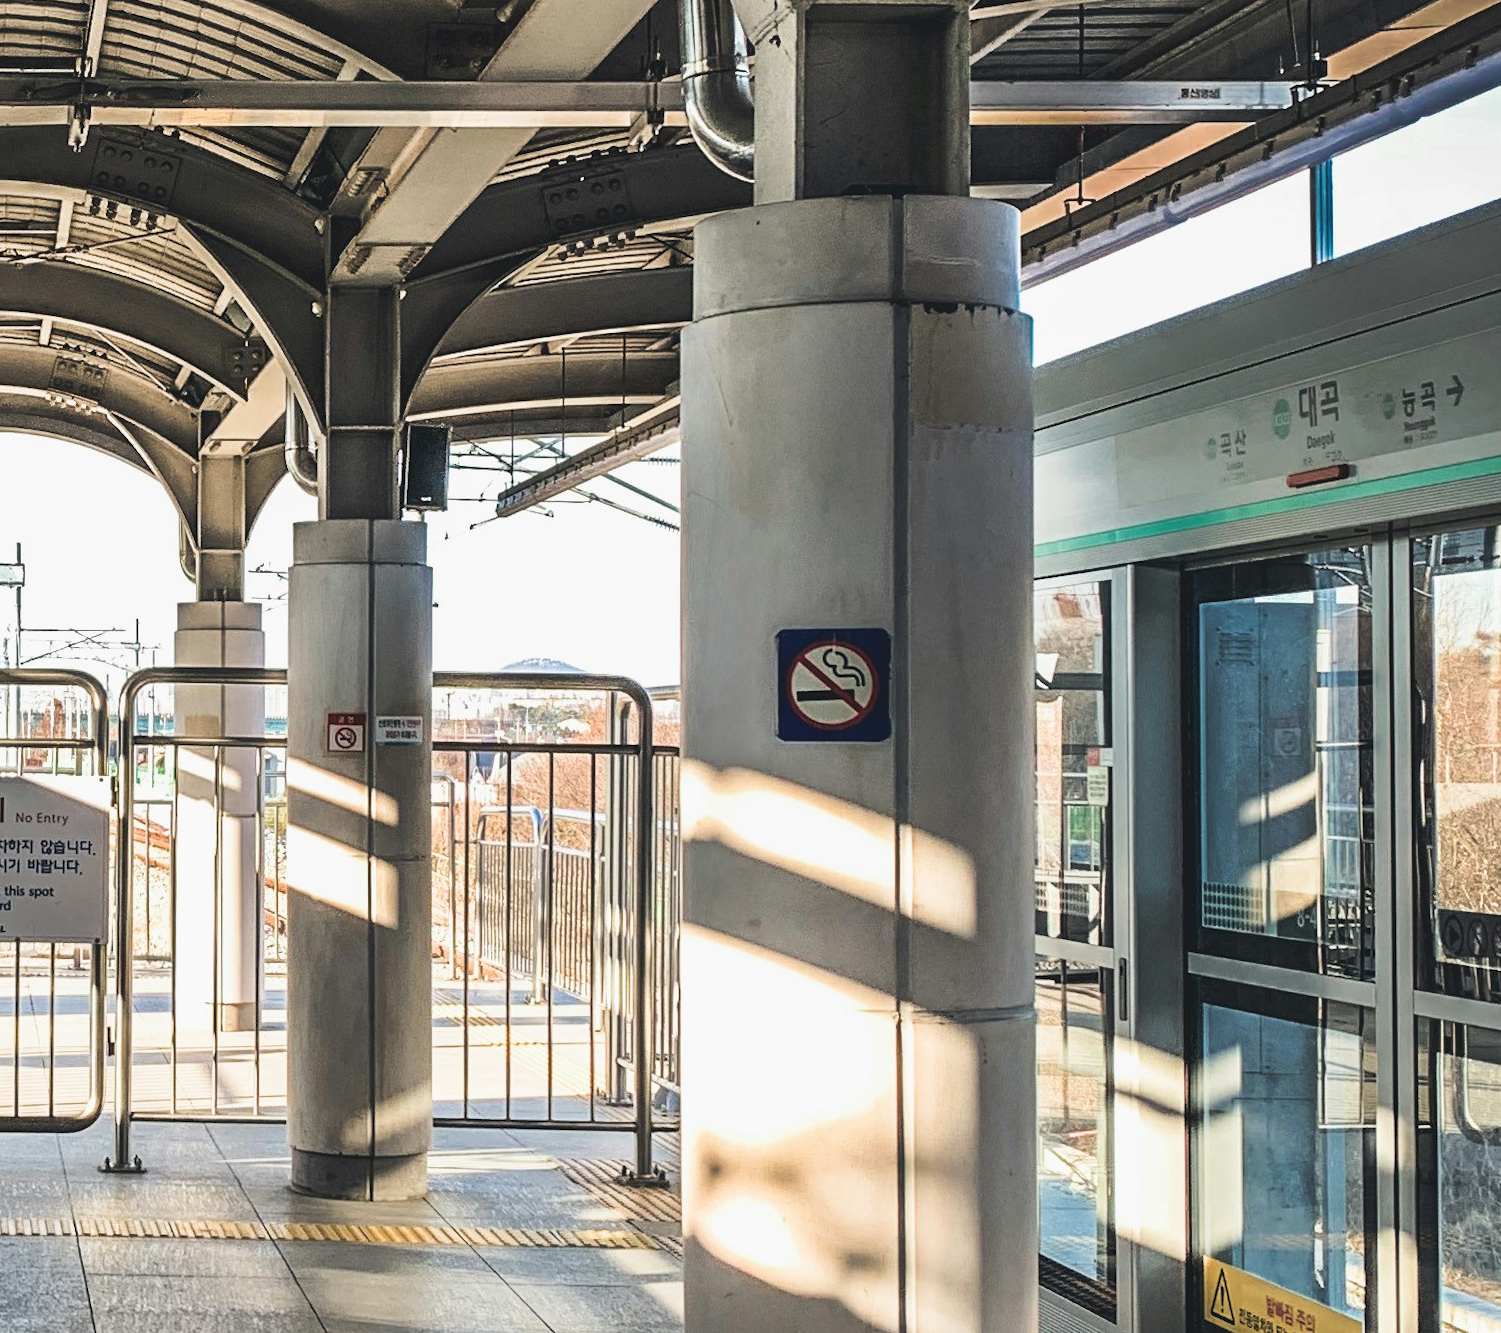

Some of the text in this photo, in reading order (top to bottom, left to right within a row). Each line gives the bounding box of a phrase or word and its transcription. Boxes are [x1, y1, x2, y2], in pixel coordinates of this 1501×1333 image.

[1298, 380, 1340, 428] 대곡
[1402, 380, 1436, 418] 능곡
[1220, 428, 1247, 458] 곡산
[1306, 429, 1337, 450] Daegok
[15, 812, 69, 826] No Entry
[41, 840, 97, 856] 않습니다.
[27, 859, 83, 875] 바랍니다.
[4, 885, 25, 897] this
[29, 886, 54, 900] spot
